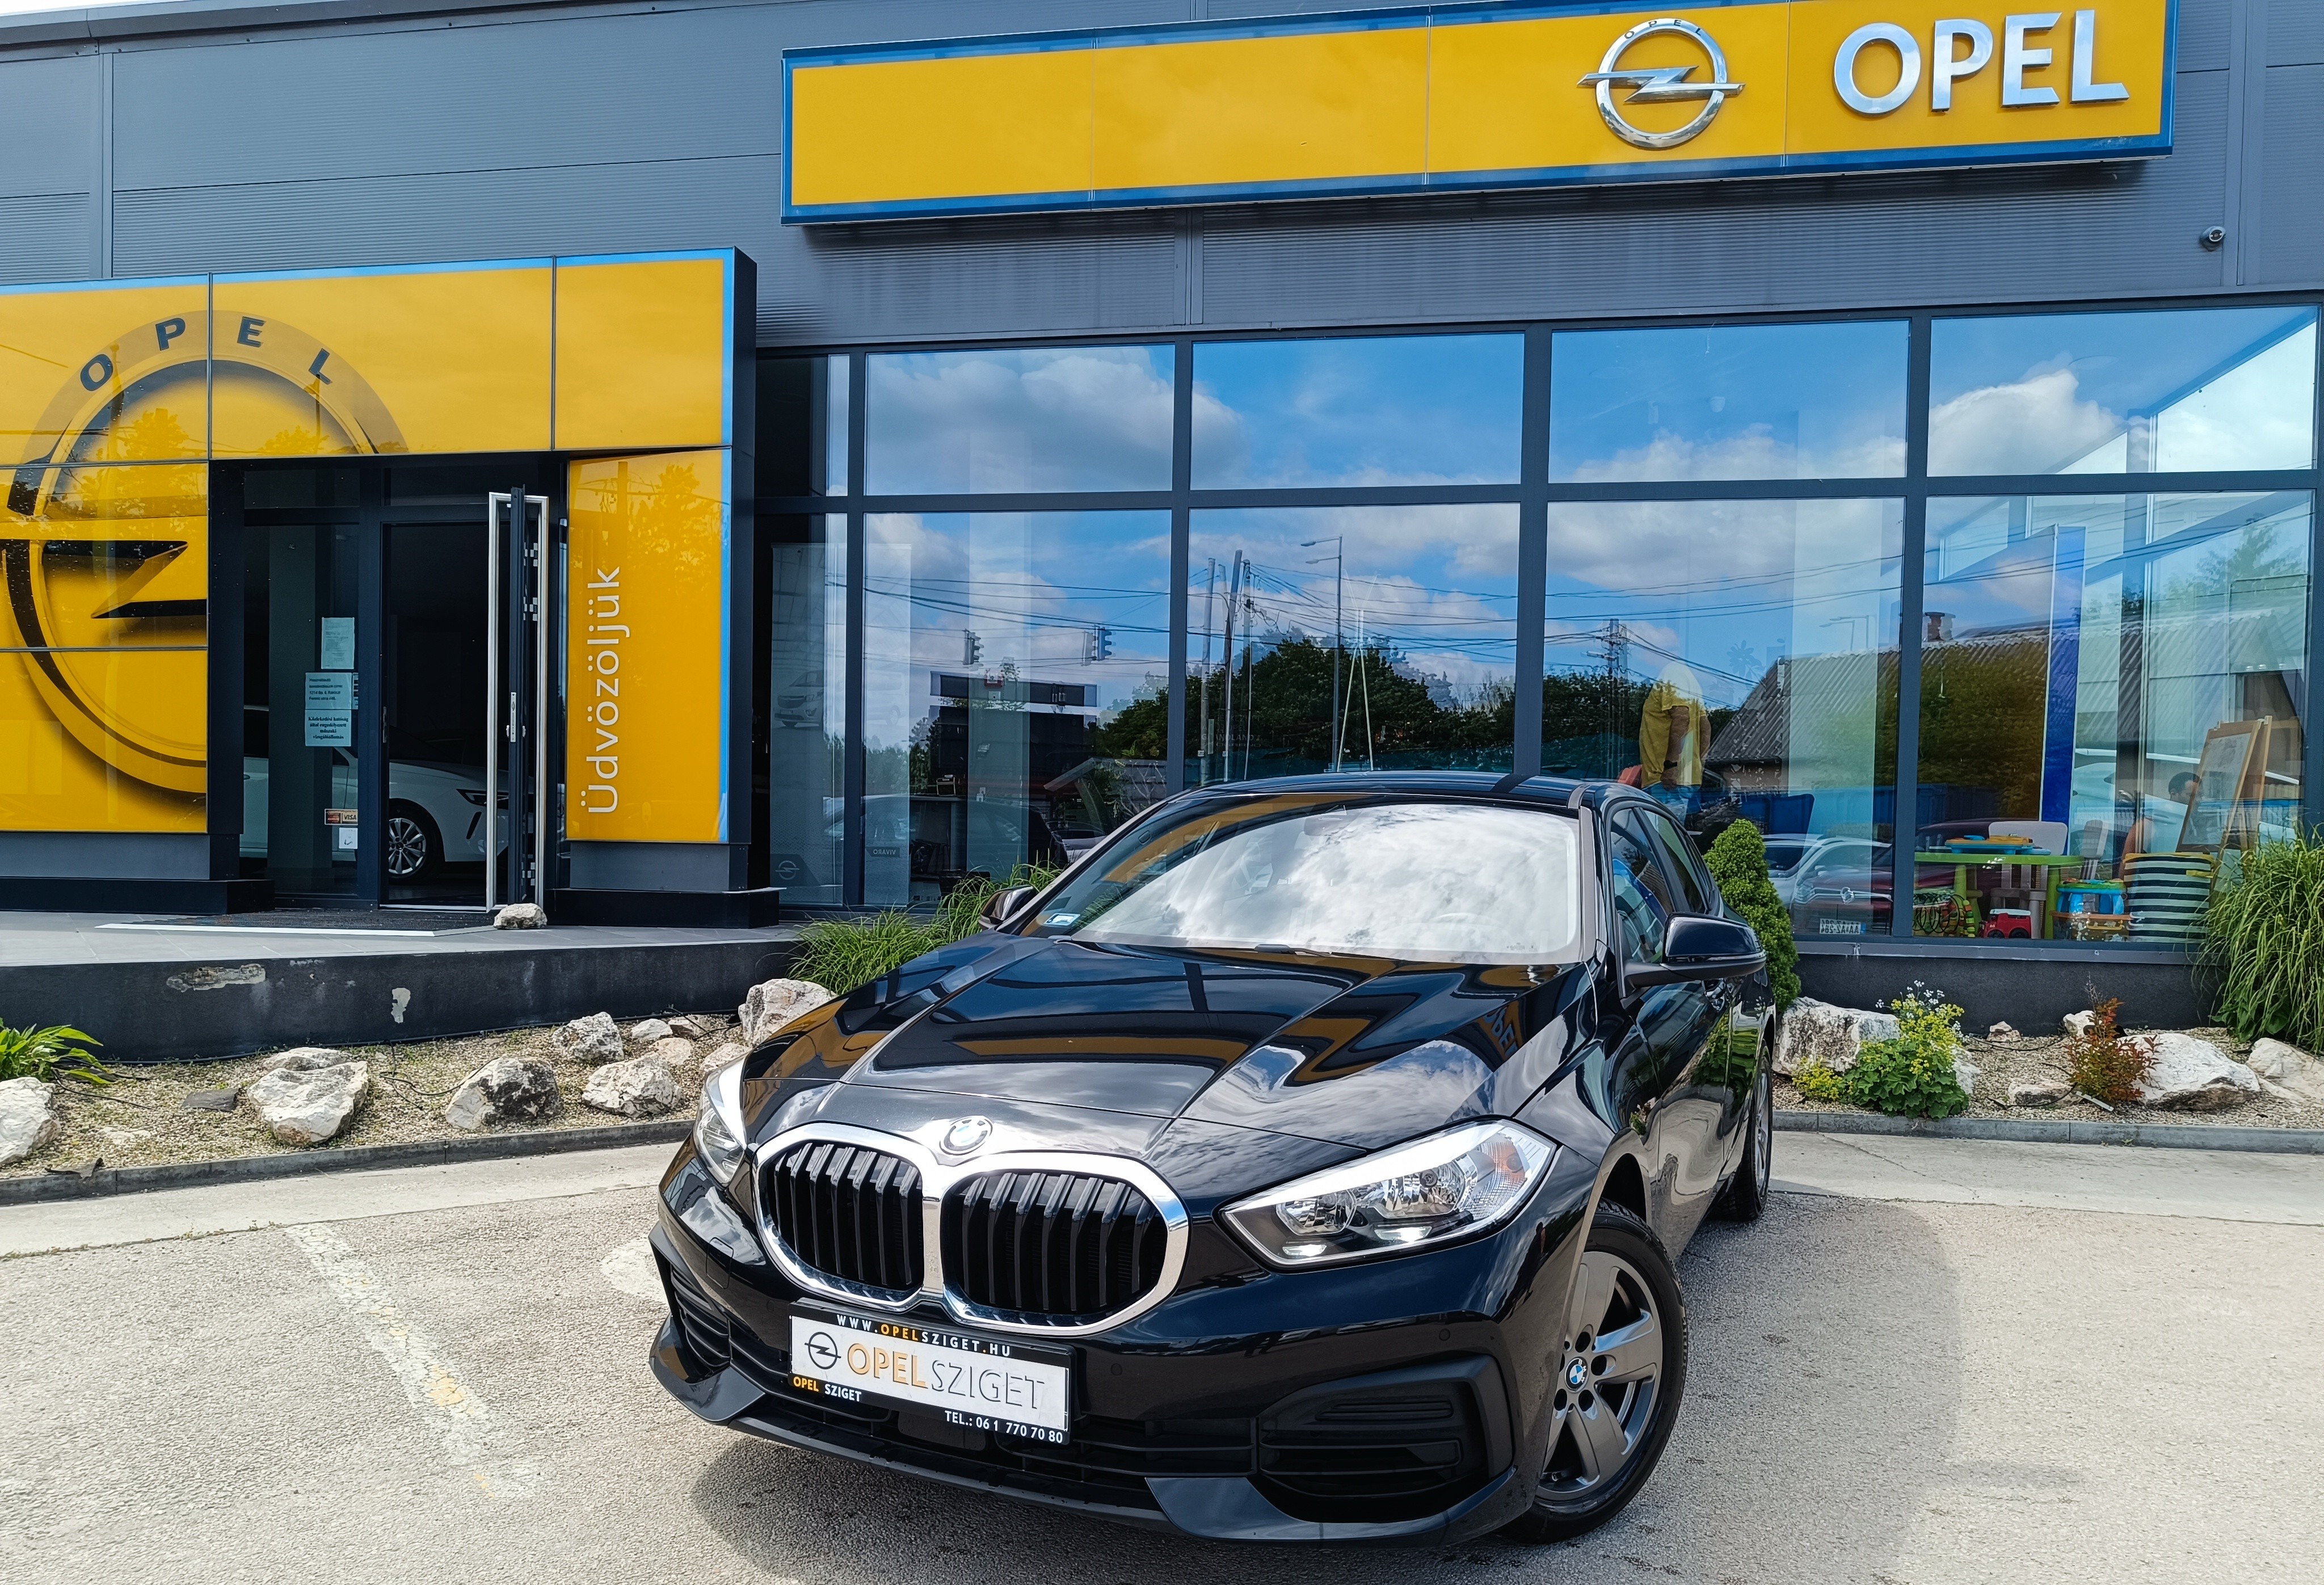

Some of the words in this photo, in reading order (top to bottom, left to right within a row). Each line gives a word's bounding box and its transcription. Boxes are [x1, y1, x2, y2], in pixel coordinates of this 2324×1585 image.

[1624, 19, 1702, 39] OPEL
[1834, 10, 2130, 115] OPEL
[80, 316, 333, 392] OPEL
[580, 566, 630, 813] Üdvözöljük
[836, 1314, 1010, 1357] WWW.OPELSZIGET.HU
[793, 1376, 819, 1392] OPEL
[824, 1384, 862, 1402] SZIGET
[945, 1410, 972, 1426] TEL.:
[1006, 1422, 1027, 1437] 770
[1030, 1427, 1045, 1440] 70
[1049, 1430, 1063, 1444] 80
